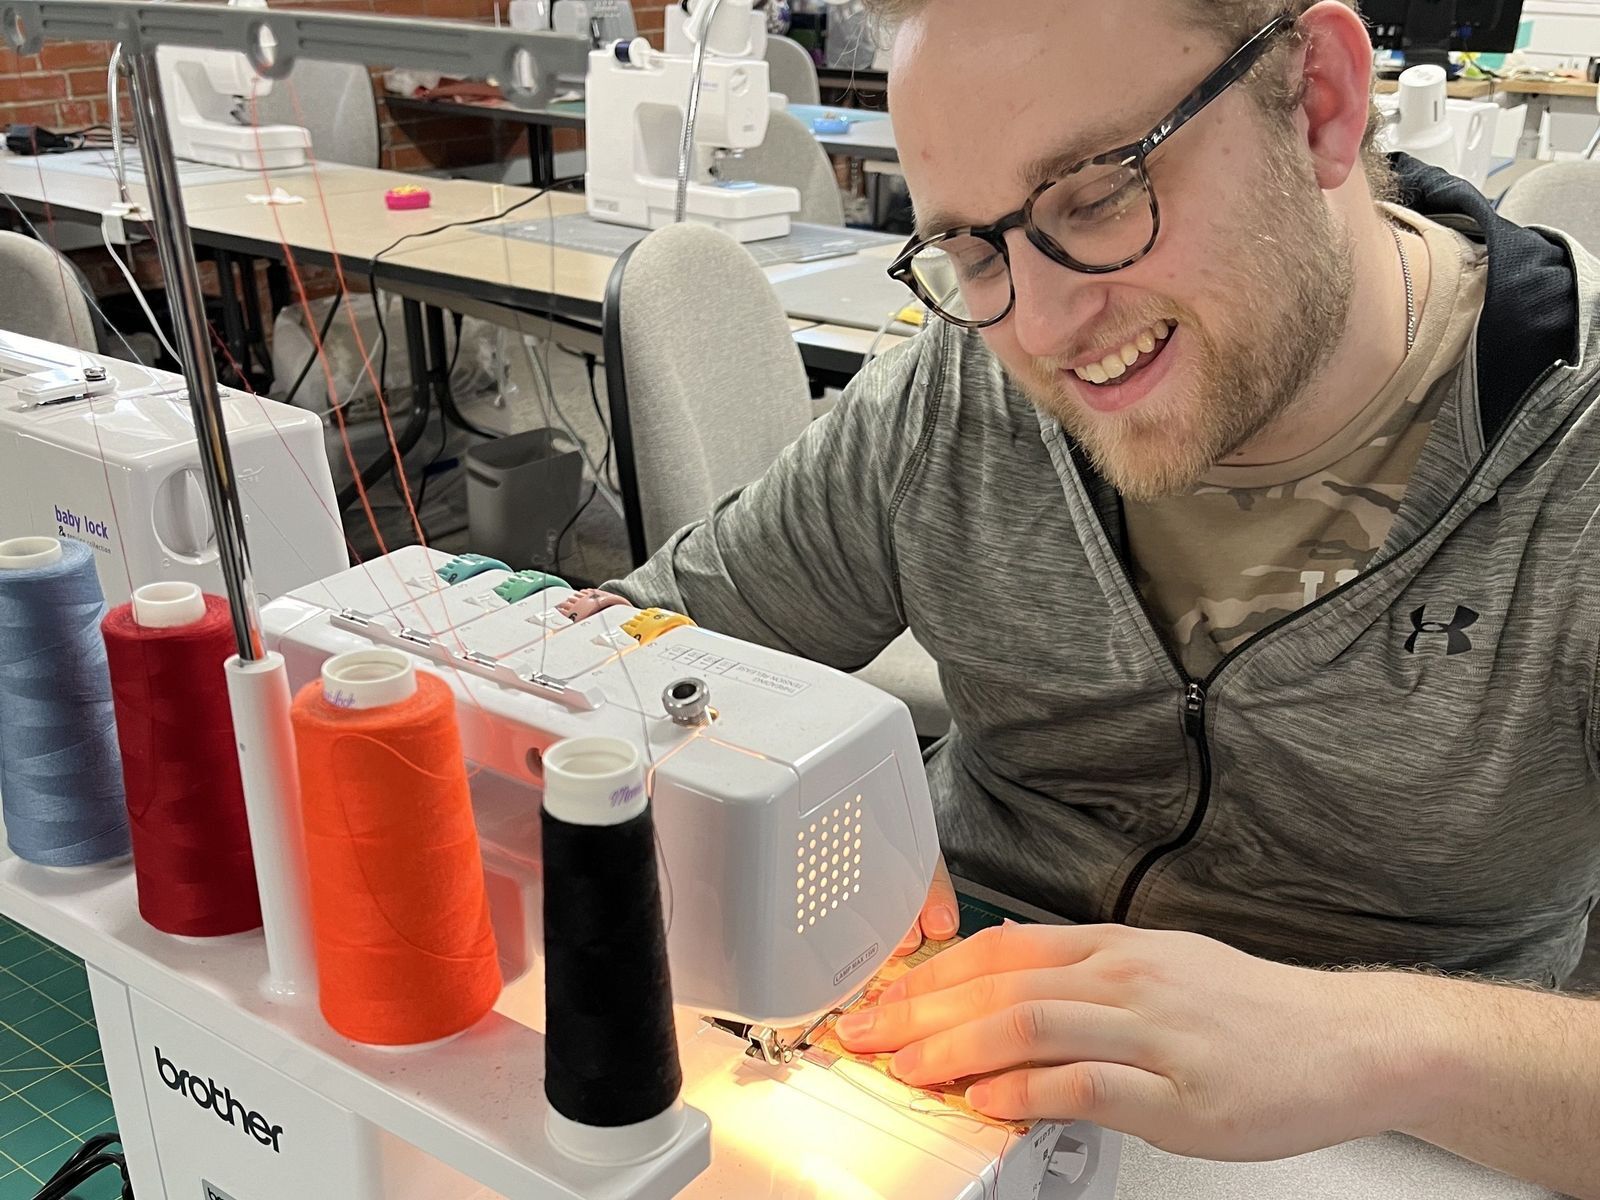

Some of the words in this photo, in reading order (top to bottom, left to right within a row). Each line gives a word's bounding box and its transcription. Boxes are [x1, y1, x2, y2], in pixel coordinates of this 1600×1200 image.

[55, 504, 81, 533] baby
[84, 515, 109, 540] lock
[835, 965, 852, 982] LAMP
[851, 956, 864, 969] MAX
[154, 1045, 284, 1153] brother
